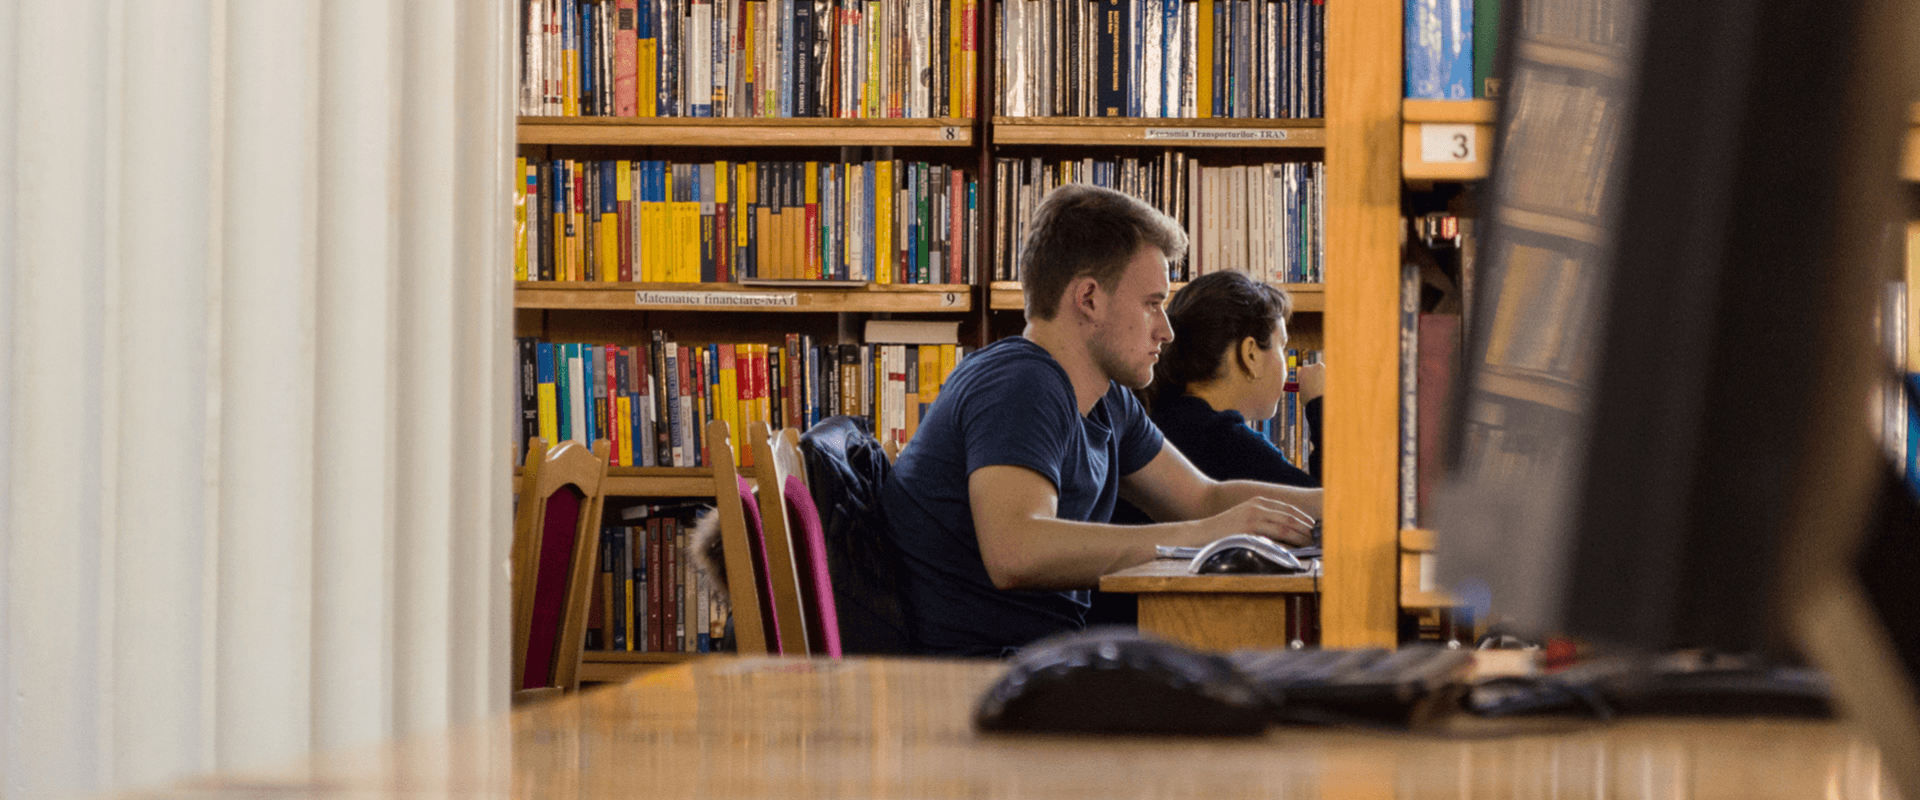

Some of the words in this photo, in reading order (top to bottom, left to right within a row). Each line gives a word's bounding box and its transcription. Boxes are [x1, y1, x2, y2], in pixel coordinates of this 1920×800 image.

[798, 53, 806, 83] ECONOMIC
[798, 84, 806, 115] DYNAMICS
[945, 127, 955, 140] 8
[1259, 130, 1286, 138] TRAN
[1452, 134, 1468, 158] 3
[636, 292, 700, 304] Matematici
[946, 293, 956, 306] 9
